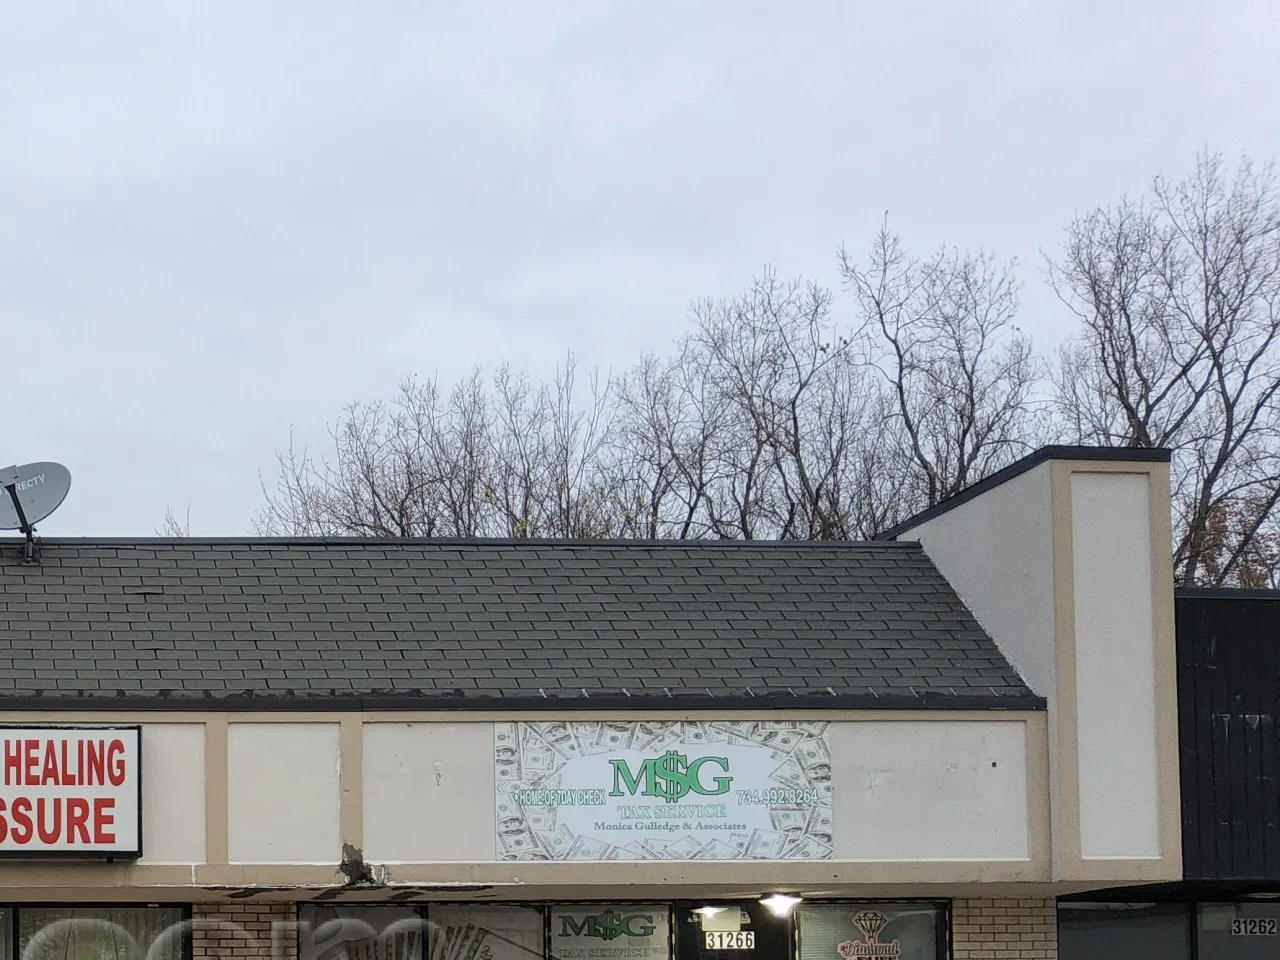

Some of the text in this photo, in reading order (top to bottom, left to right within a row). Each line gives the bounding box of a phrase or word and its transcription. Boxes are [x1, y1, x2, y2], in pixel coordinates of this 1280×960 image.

[4, 739, 126, 787] HEALING
[519, 788, 544, 807] HOME
[577, 789, 606, 806] CHECK
[736, 788, 819, 806] 734.992.8264
[617, 804, 728, 819] TAX SERVICE
[594, 822, 747, 832] Monica Gulledge & Associates
[1233, 919, 1276, 934] 31262
[707, 932, 753, 949] 31266
